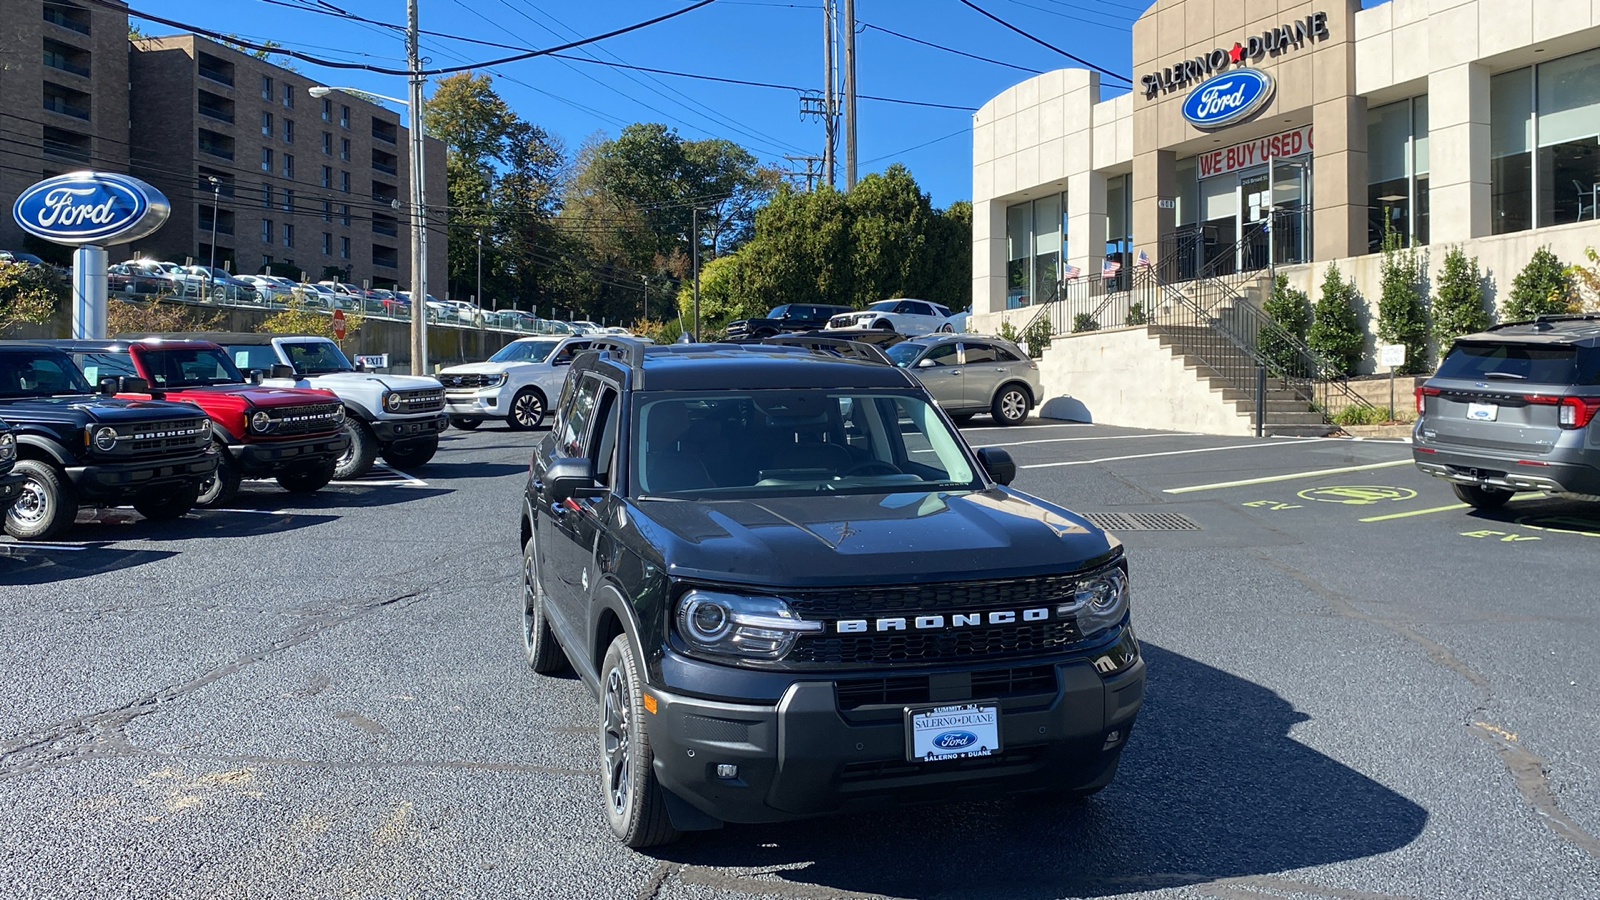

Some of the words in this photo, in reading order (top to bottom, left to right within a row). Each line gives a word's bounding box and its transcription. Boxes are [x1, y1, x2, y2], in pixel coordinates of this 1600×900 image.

[1140, 48, 1229, 96] SALERNO
[1246, 12, 1328, 59] DUANE
[1197, 81, 1245, 118] Ford
[1200, 150, 1222, 176] WE
[1226, 142, 1257, 171] BUY
[1260, 131, 1302, 162] USED
[38, 187, 118, 227] Ford
[366, 357, 383, 366] EXIT
[1447, 391, 1510, 400] EXPLORER
[283, 413, 331, 422] BRONCO
[134, 429, 195, 440] BRONCO
[1241, 499, 1304, 511] EV
[1459, 529, 1541, 542] EV
[836, 607, 1049, 633] BRONCO
[915, 716, 957, 729] SALERNO
[961, 713, 994, 724] DUANE
[941, 733, 969, 747] Ford
[924, 753, 958, 762] SALERNO
[968, 749, 992, 758] DUANE
